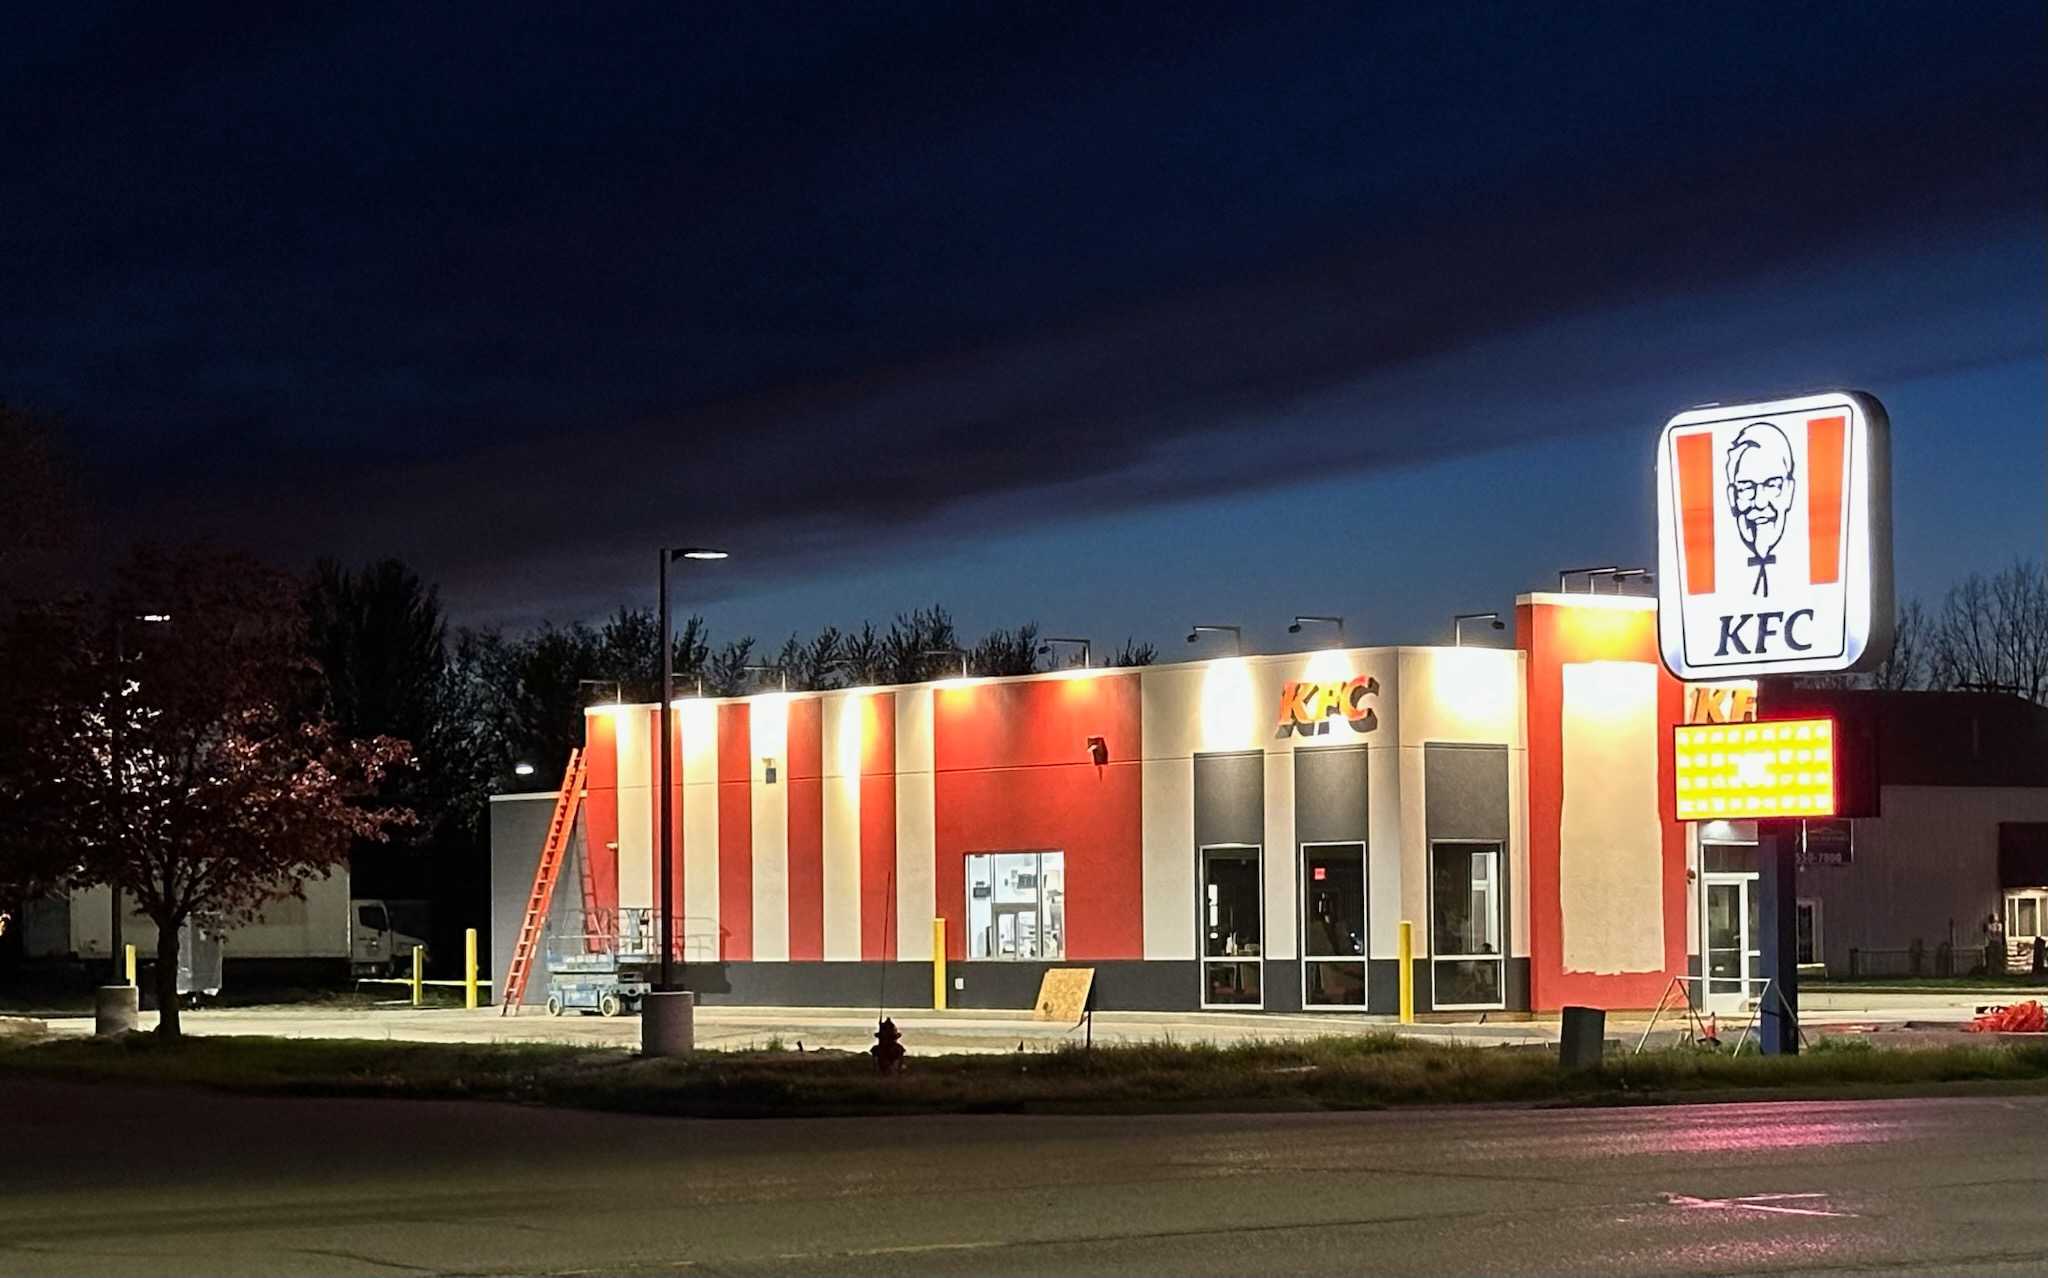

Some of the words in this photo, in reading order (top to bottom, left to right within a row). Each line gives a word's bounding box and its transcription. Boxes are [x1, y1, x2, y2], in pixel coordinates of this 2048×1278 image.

[1714, 608, 1814, 656] KFC
[1277, 675, 1379, 737] KFC
[1690, 687, 1757, 723] KF
